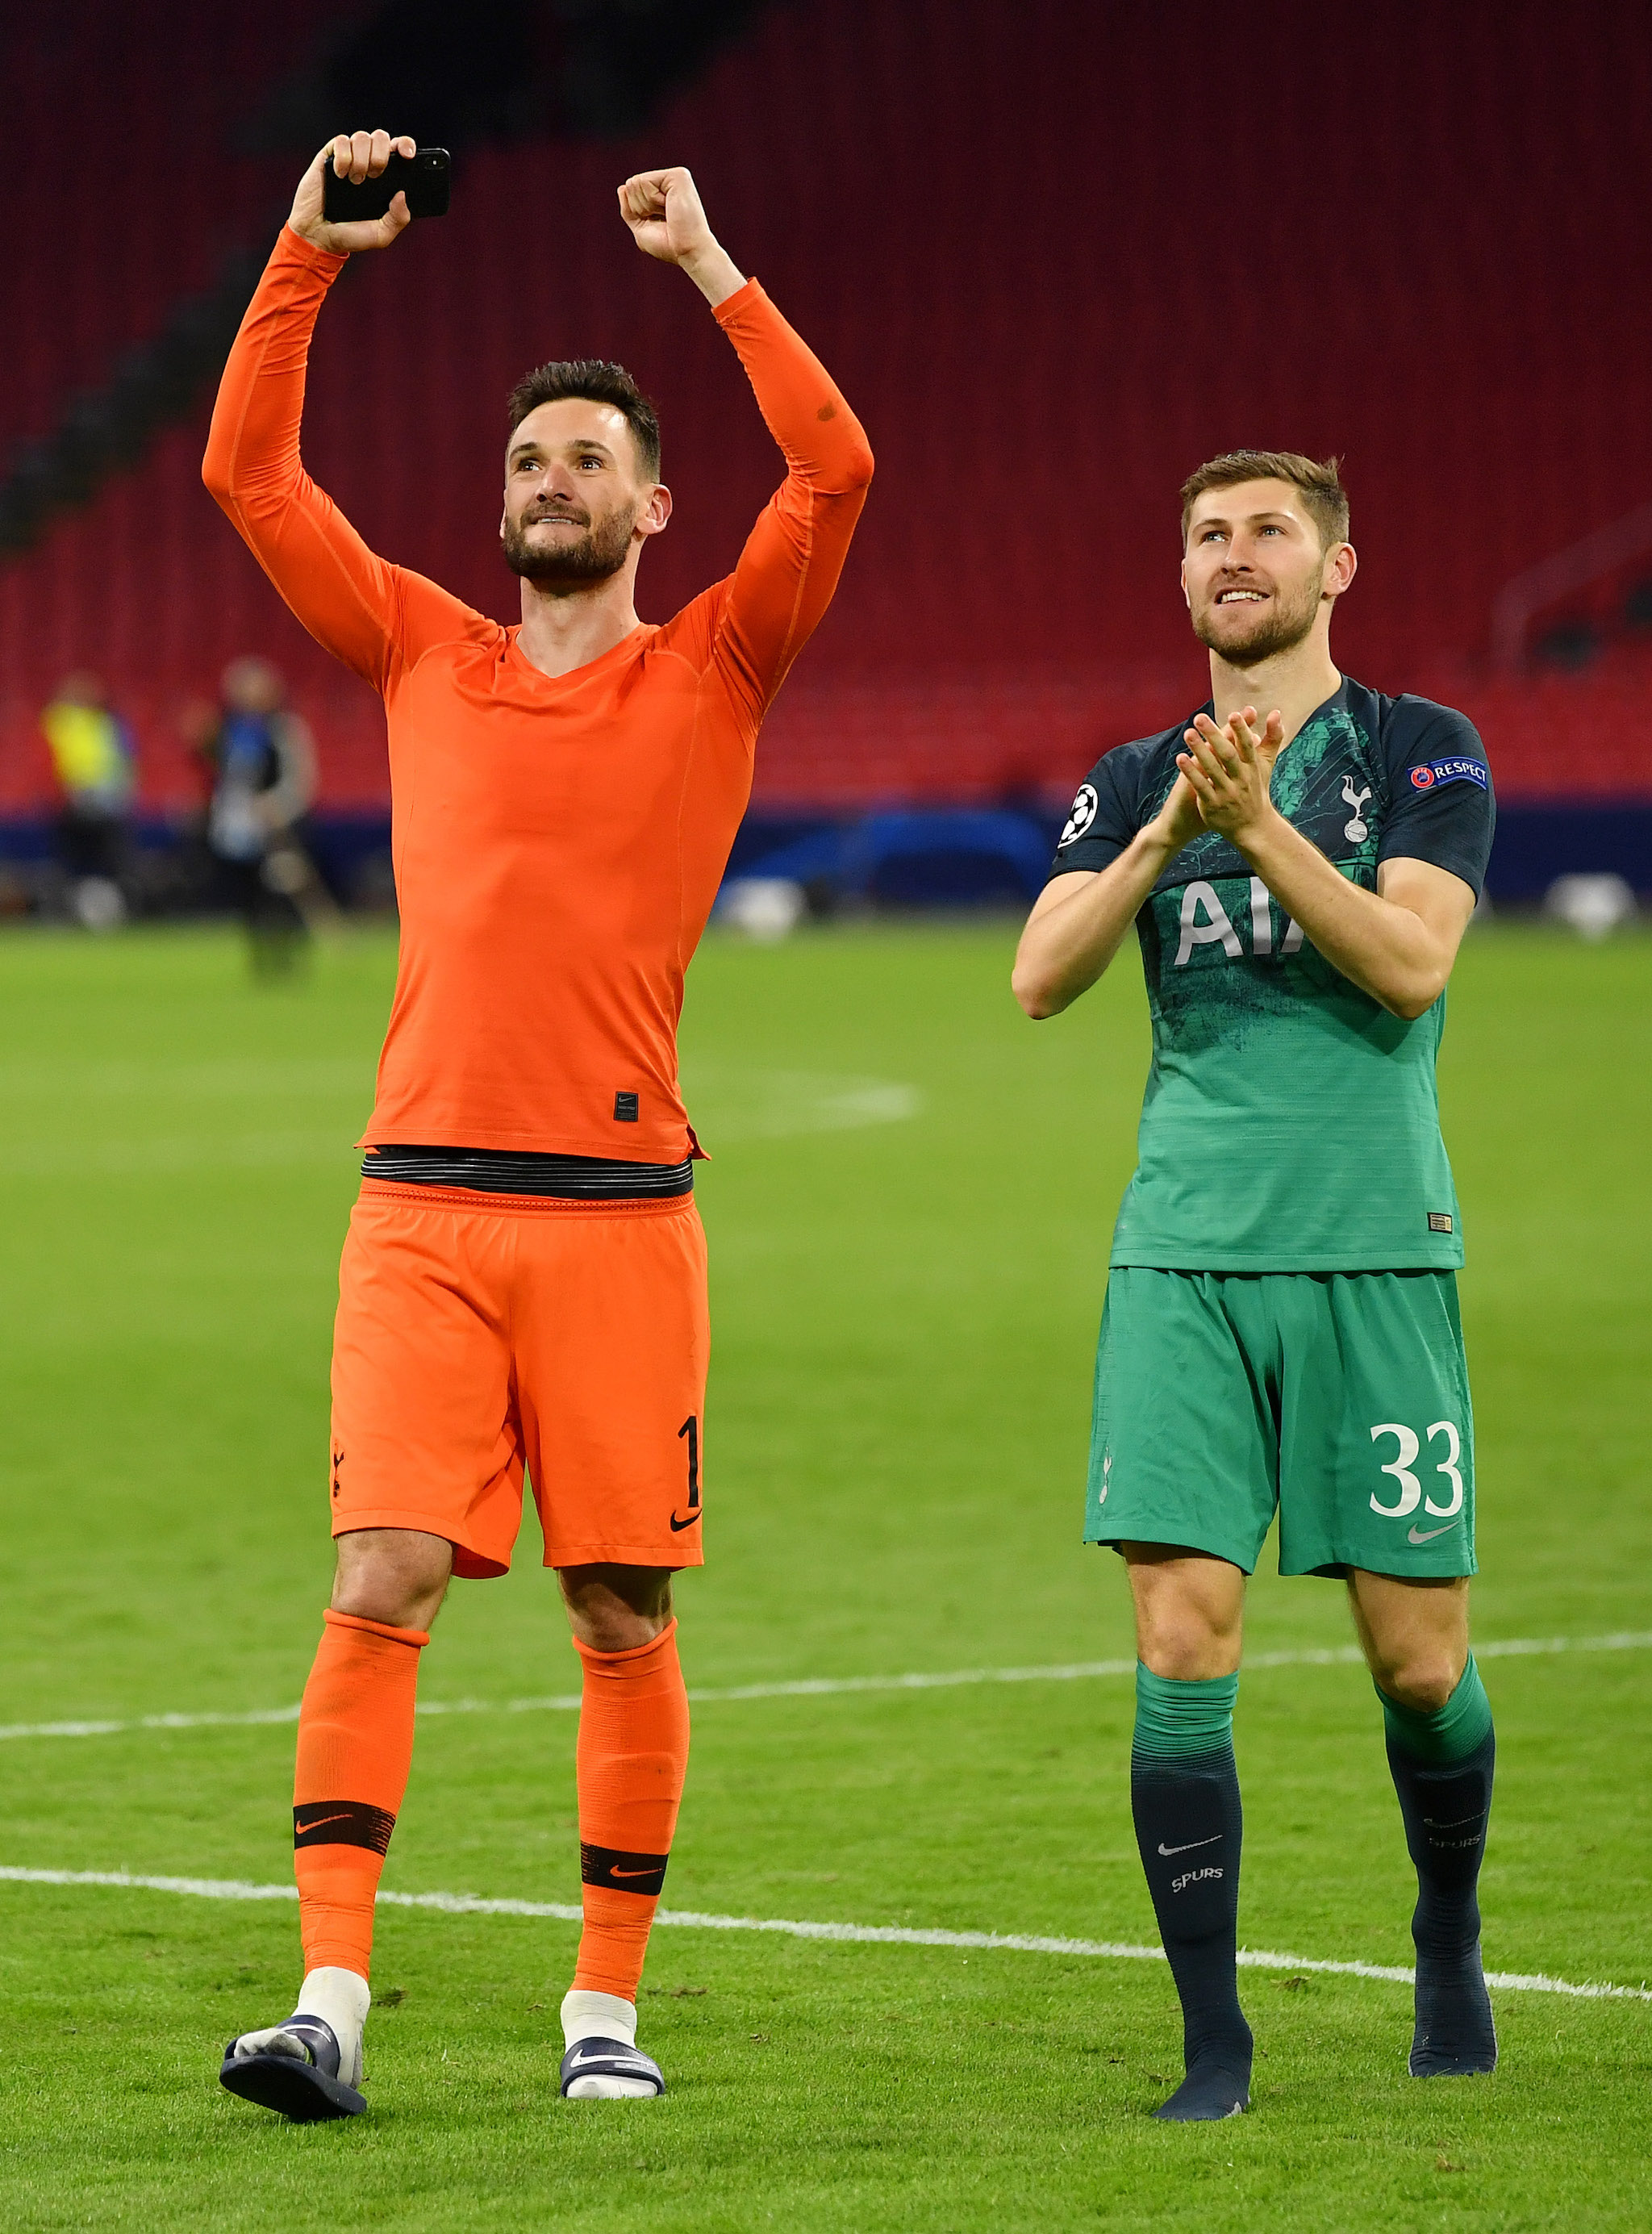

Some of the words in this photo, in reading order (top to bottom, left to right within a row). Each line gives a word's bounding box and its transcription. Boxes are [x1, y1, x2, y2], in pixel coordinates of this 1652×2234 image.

[1435, 762, 1486, 782] RESPECT
[678, 1415, 699, 1508] 1
[1370, 1421, 1463, 1517] 33
[1171, 1867, 1224, 1894] SPURS
